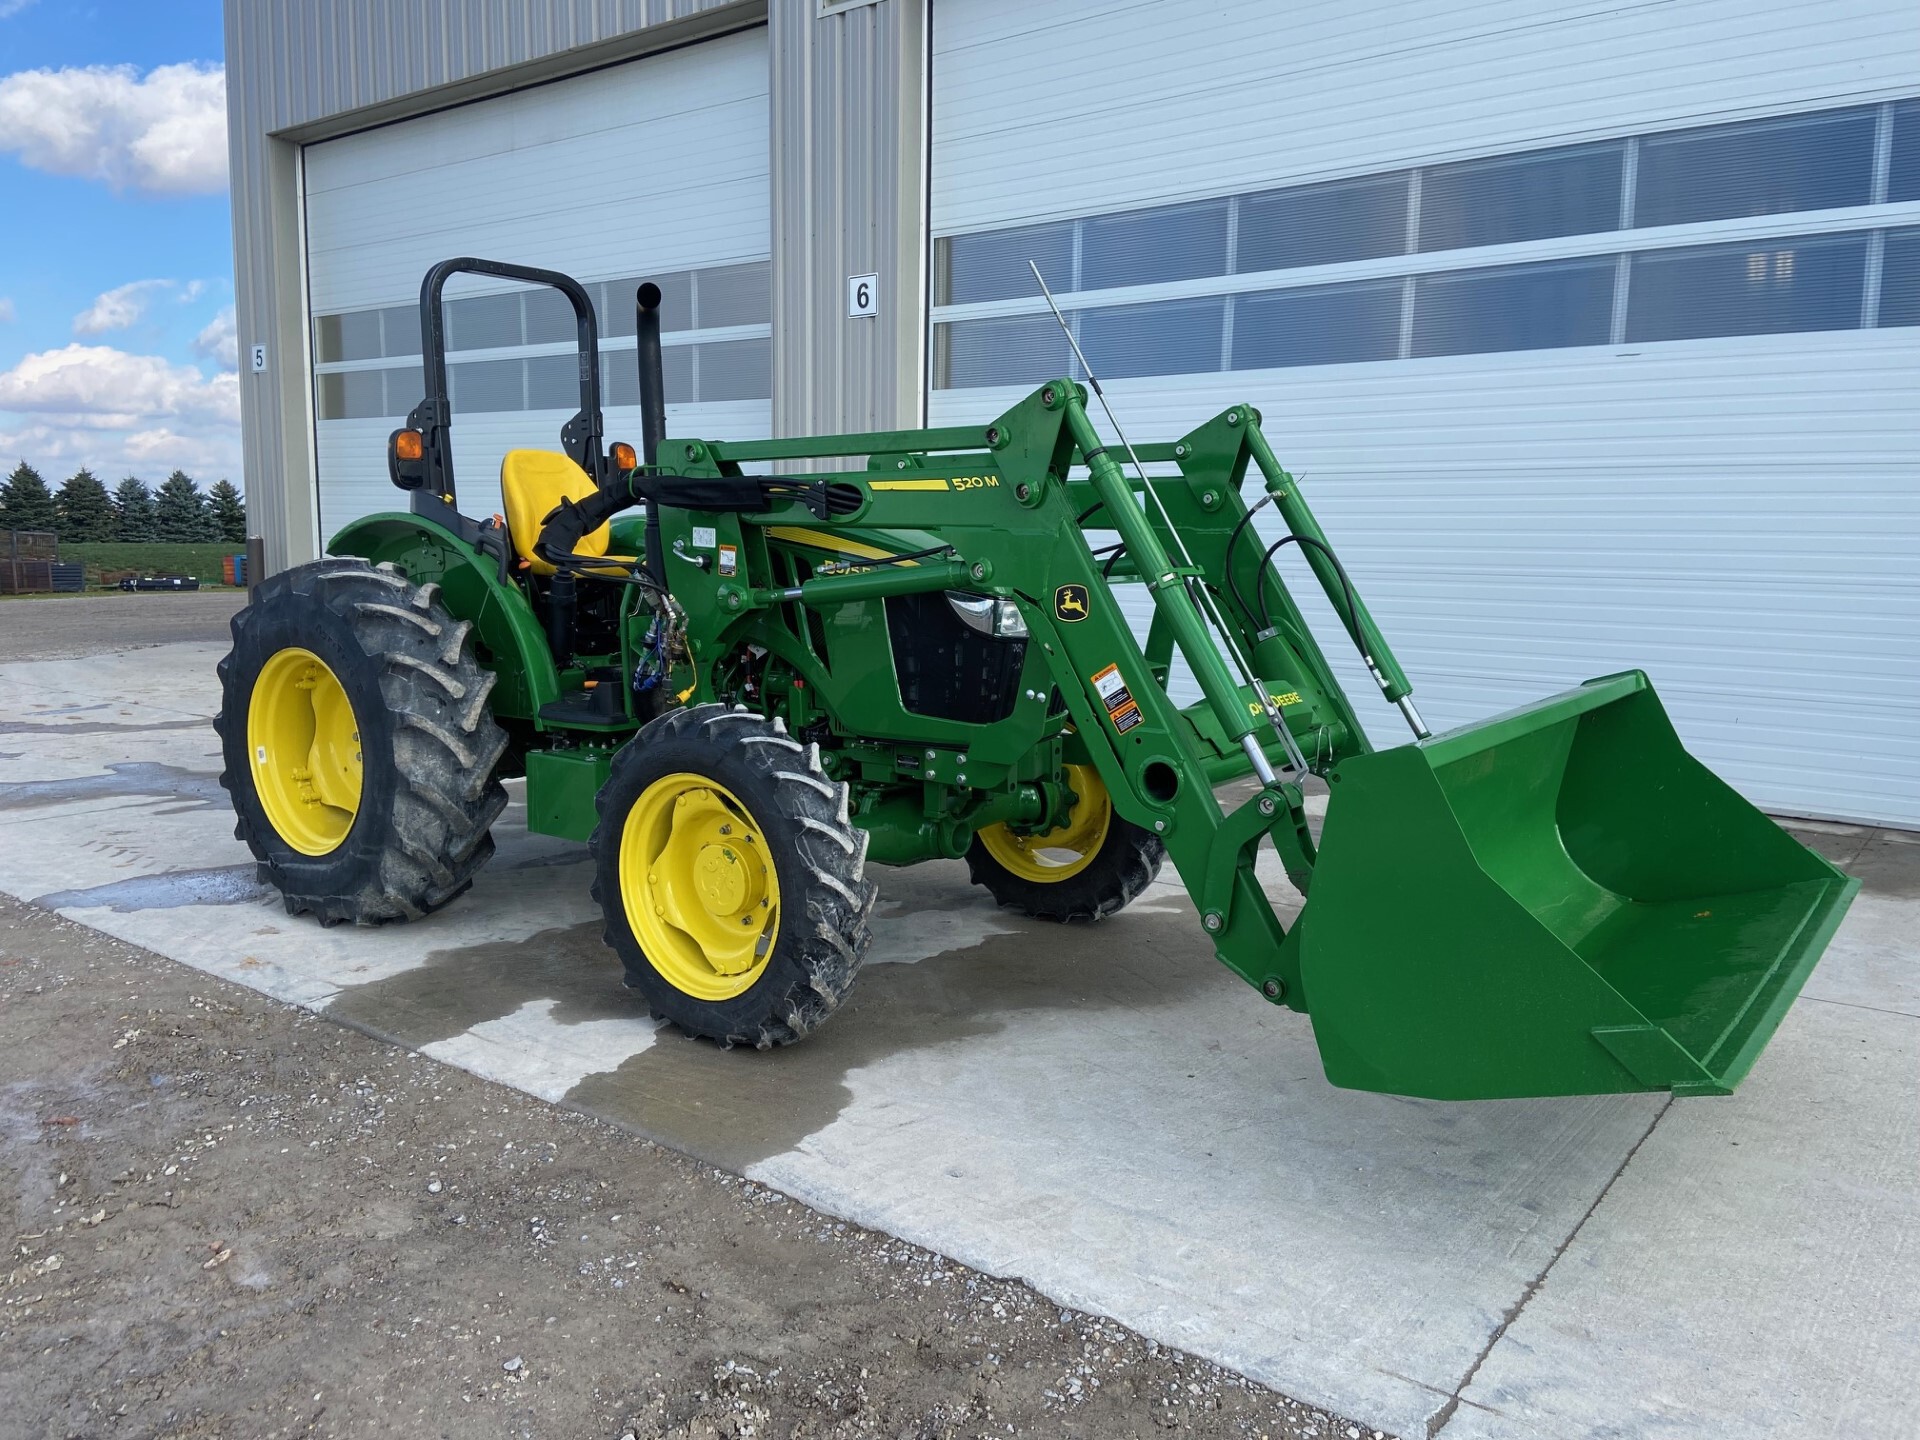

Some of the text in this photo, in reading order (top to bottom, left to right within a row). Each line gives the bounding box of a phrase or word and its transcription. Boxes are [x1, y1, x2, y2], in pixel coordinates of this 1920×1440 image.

[857, 282, 869, 309] 6
[256, 349, 263, 367] 5
[951, 475, 1000, 491] 520 M
[1269, 692, 1303, 708] DEERE
